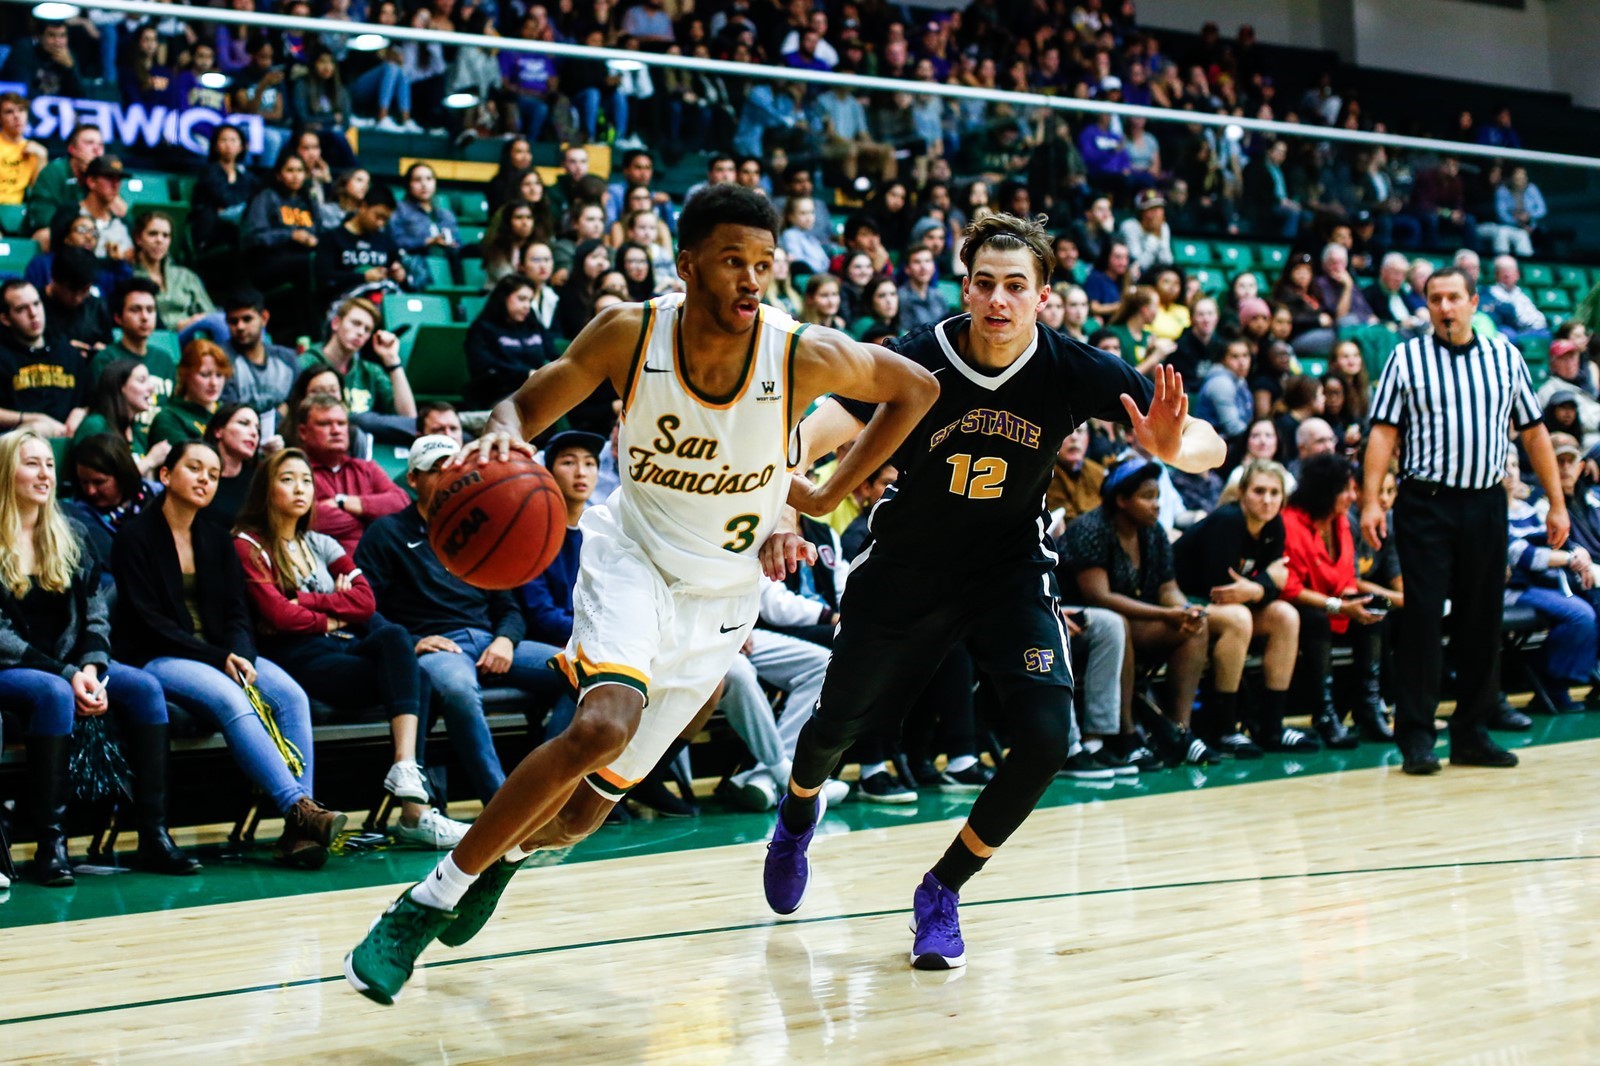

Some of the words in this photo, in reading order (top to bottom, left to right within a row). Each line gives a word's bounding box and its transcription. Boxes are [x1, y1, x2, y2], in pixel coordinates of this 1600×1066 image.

[653, 413, 719, 461] San
[960, 408, 1041, 450] STATE
[628, 446, 776, 495] Francisco
[946, 453, 1009, 500] 12
[442, 507, 490, 558] NCAA
[722, 511, 763, 554] 3
[1024, 648, 1054, 673] SF
